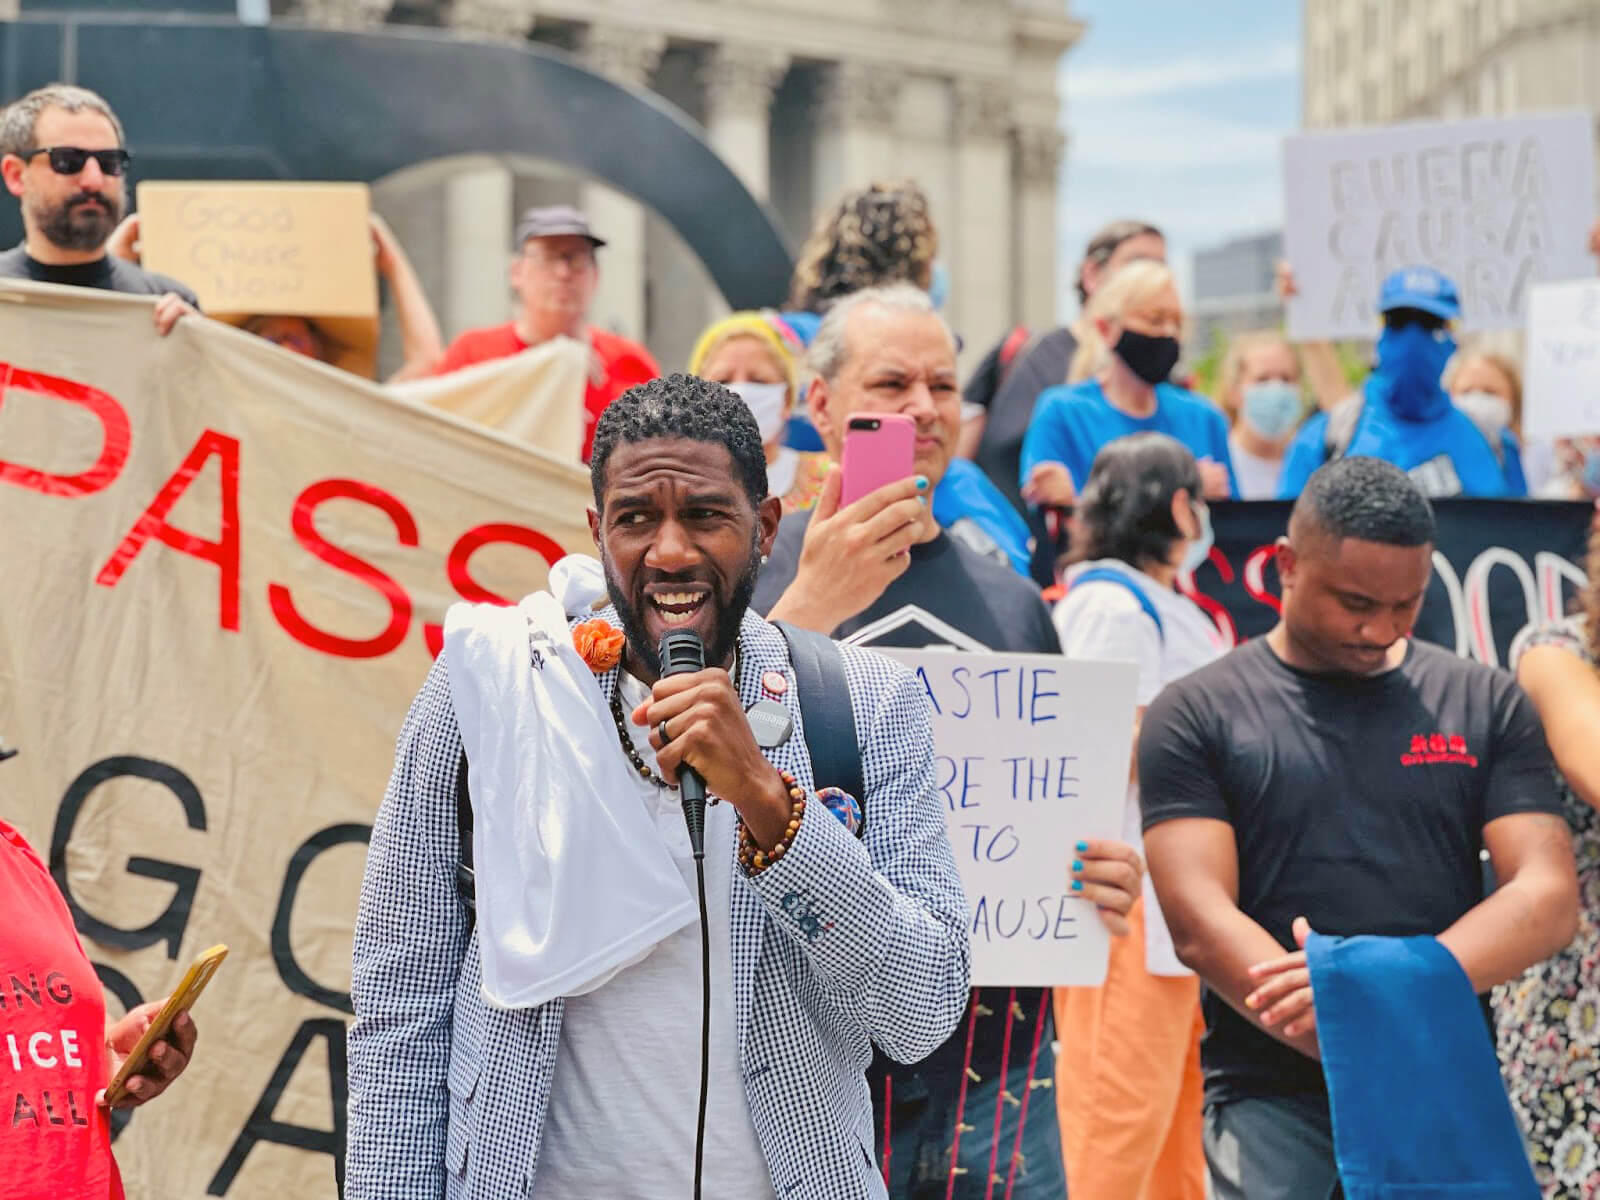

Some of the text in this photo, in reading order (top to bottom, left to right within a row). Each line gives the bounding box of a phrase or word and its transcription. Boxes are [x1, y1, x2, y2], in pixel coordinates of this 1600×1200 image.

[1003, 757, 1080, 802] THE
[962, 825, 1020, 863] TO
[973, 895, 1079, 942] AUSE
[7, 1030, 82, 1071] ICE
[13, 1090, 88, 1127] ALL
